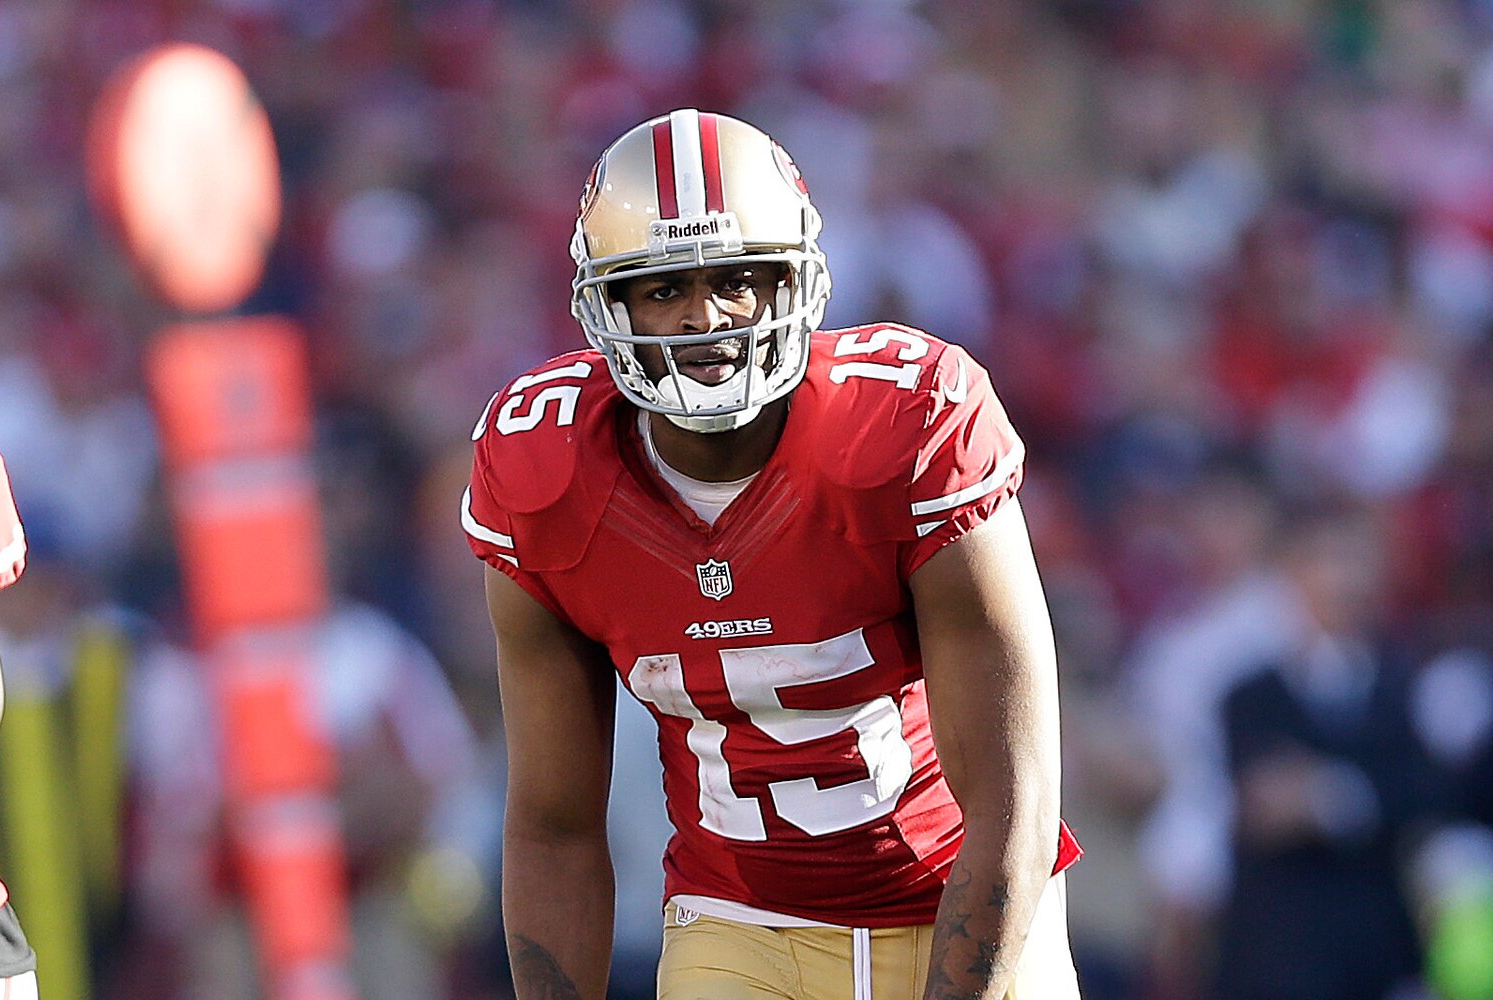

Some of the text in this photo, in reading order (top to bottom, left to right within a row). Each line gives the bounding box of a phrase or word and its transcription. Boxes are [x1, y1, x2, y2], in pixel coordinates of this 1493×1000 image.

[668, 218, 719, 238] Riddell
[828, 328, 930, 389] 15
[495, 361, 592, 435] 15
[705, 577, 728, 593] NFL
[684, 617, 774, 639] 49ERS
[628, 628, 912, 841] 15
